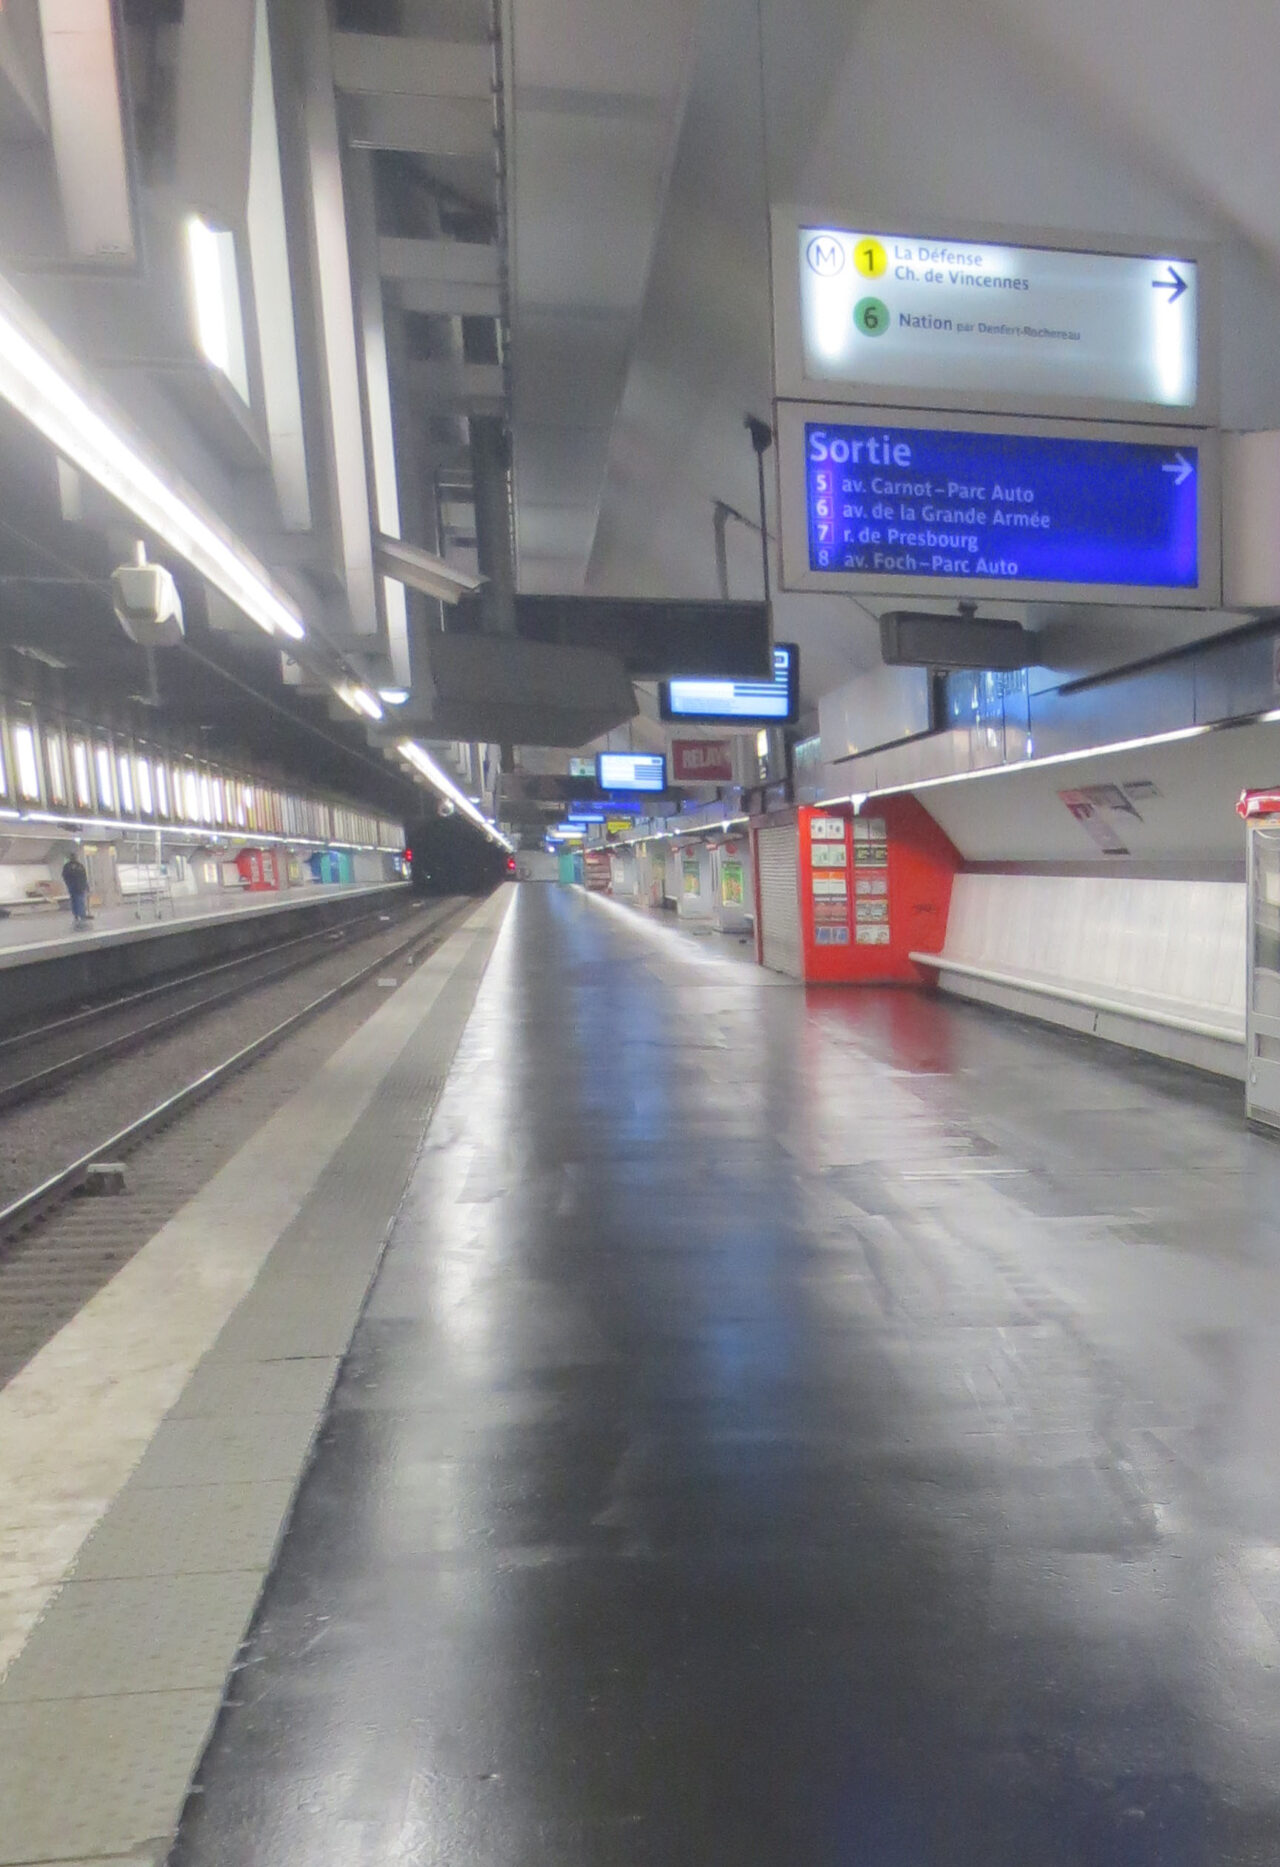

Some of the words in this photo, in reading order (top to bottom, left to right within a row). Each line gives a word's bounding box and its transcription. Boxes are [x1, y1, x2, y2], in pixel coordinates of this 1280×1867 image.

[815, 244, 837, 267] M
[863, 249, 875, 272] 1
[895, 245, 913, 260] La
[919, 247, 983, 267] Défense
[895, 265, 920, 282] Ch.
[925, 268, 943, 284] de
[949, 272, 1030, 291] Vincennes
[863, 306, 878, 329] 6
[899, 313, 953, 331] Nation
[809, 431, 912, 467] Sortie
[816, 474, 827, 491] 5
[842, 478, 867, 493] av.
[991, 485, 1034, 502] Auto
[816, 499, 828, 516] 6
[843, 504, 868, 519] av.
[872, 503, 894, 520] de
[900, 503, 916, 521] la
[922, 505, 987, 525] Grande
[992, 509, 1050, 528] Armée
[817, 524, 829, 541] 7
[844, 529, 855, 543] r.
[858, 527, 881, 544] de
[887, 528, 979, 553] Presbourg
[818, 550, 829, 567] 8
[845, 554, 869, 568] av.
[976, 557, 1018, 575] Auto
